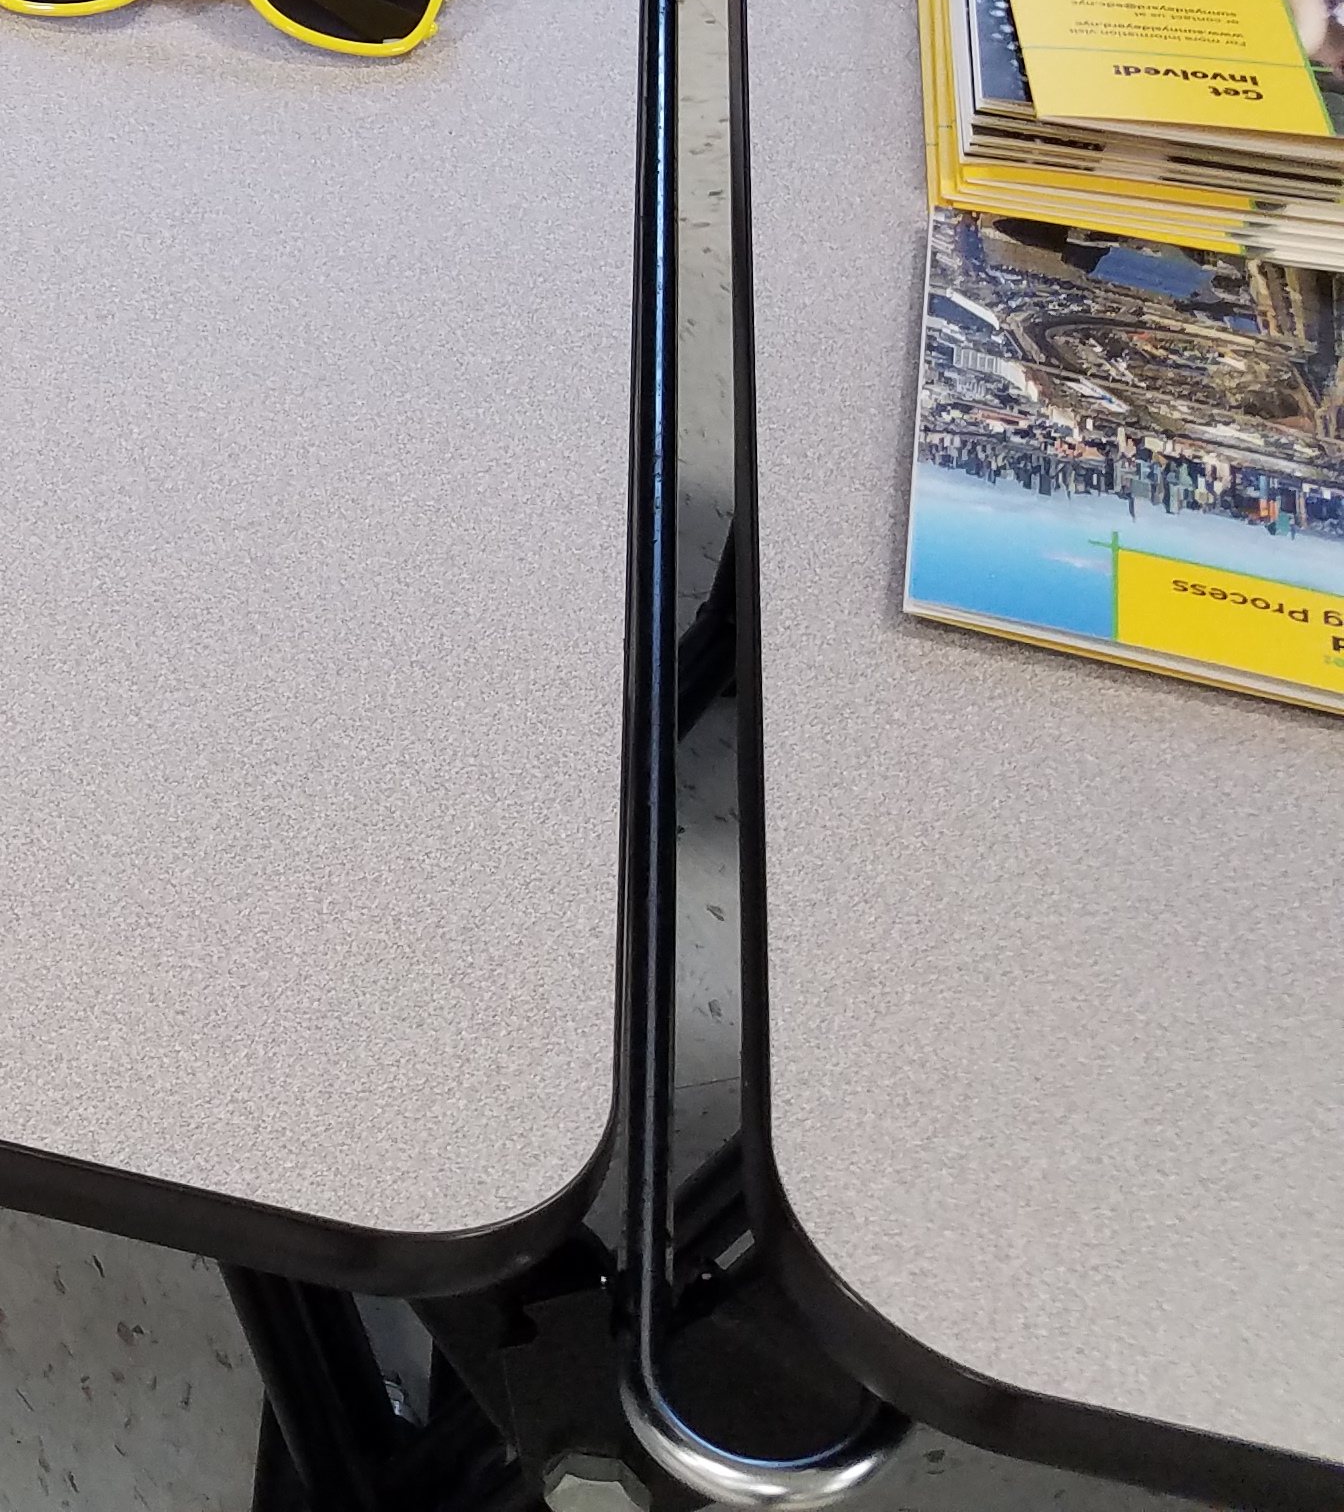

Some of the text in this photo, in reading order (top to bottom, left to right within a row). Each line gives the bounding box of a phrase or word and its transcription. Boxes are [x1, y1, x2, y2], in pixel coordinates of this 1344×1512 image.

[1170, 14, 1222, 25] contact
[1069, 28, 1247, 48] For more information visit
[1112, 64, 1260, 87] Involved!
[1208, 85, 1264, 101] Get
[1171, 578, 1310, 624] Process
